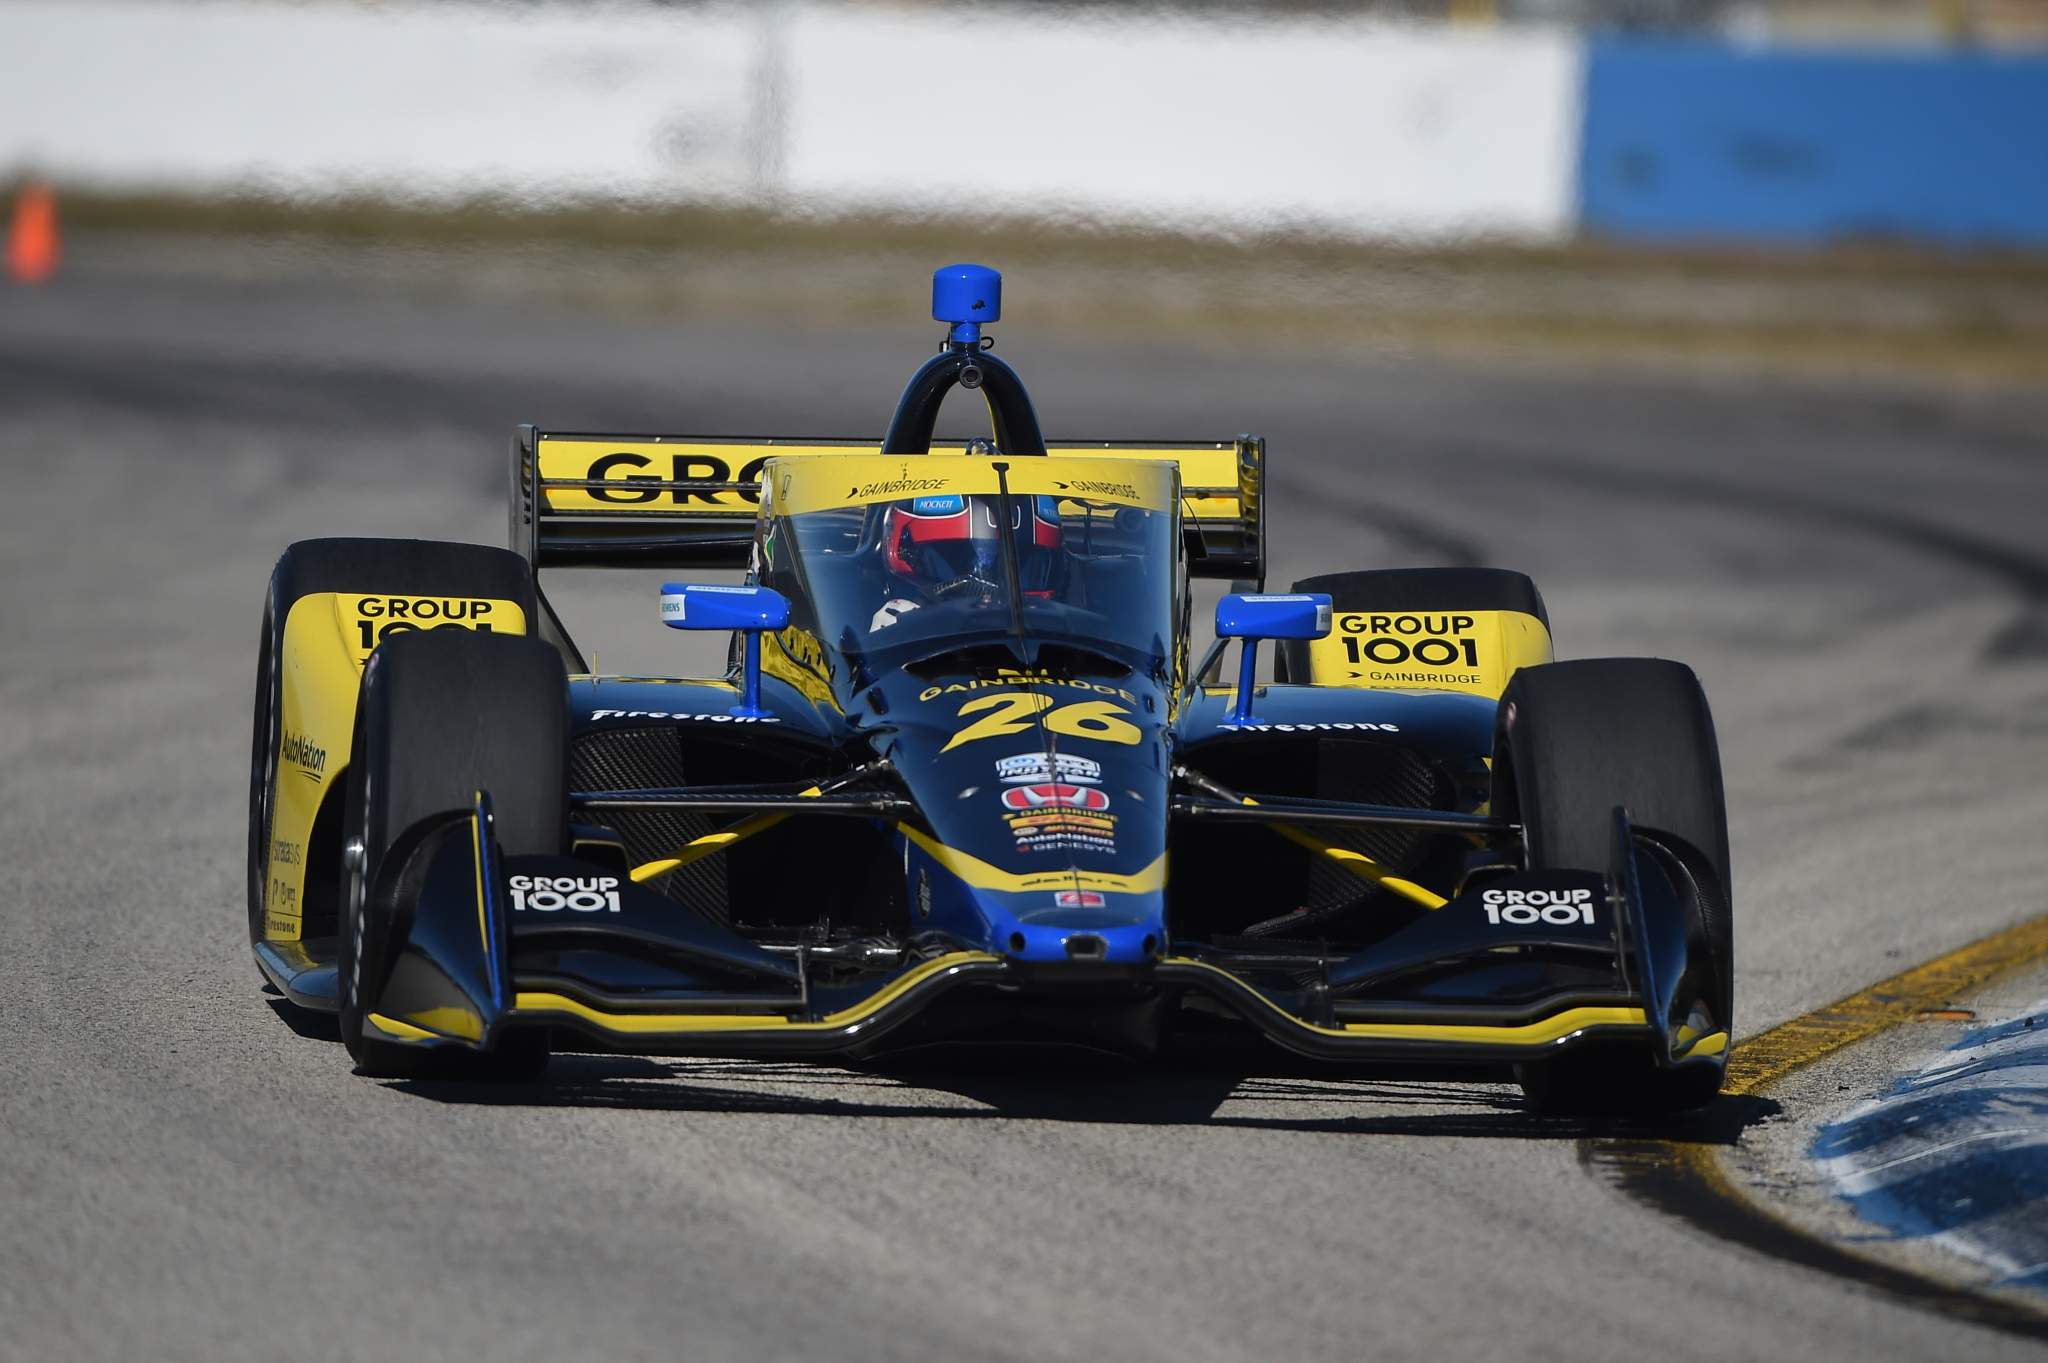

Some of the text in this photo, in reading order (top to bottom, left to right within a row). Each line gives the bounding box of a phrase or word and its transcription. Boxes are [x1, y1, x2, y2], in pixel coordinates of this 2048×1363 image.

[860, 479, 949, 498] GAINBRIDGE
[1070, 480, 1141, 499] GAINBRIDGE
[357, 597, 492, 620] GROUP
[1339, 615, 1474, 635] GROUP
[1341, 636, 1479, 667] 1001
[1369, 671, 1481, 684] GAINBRIDGE
[919, 676, 1138, 705] GAINBRIDGE
[591, 709, 781, 723] Firestone
[939, 692, 1142, 754] 26
[281, 730, 326, 773] AutoNation
[509, 875, 619, 892] GROUP
[510, 889, 621, 912] 1001
[1482, 889, 1592, 905] GROUP
[1483, 903, 1595, 925] 1001
